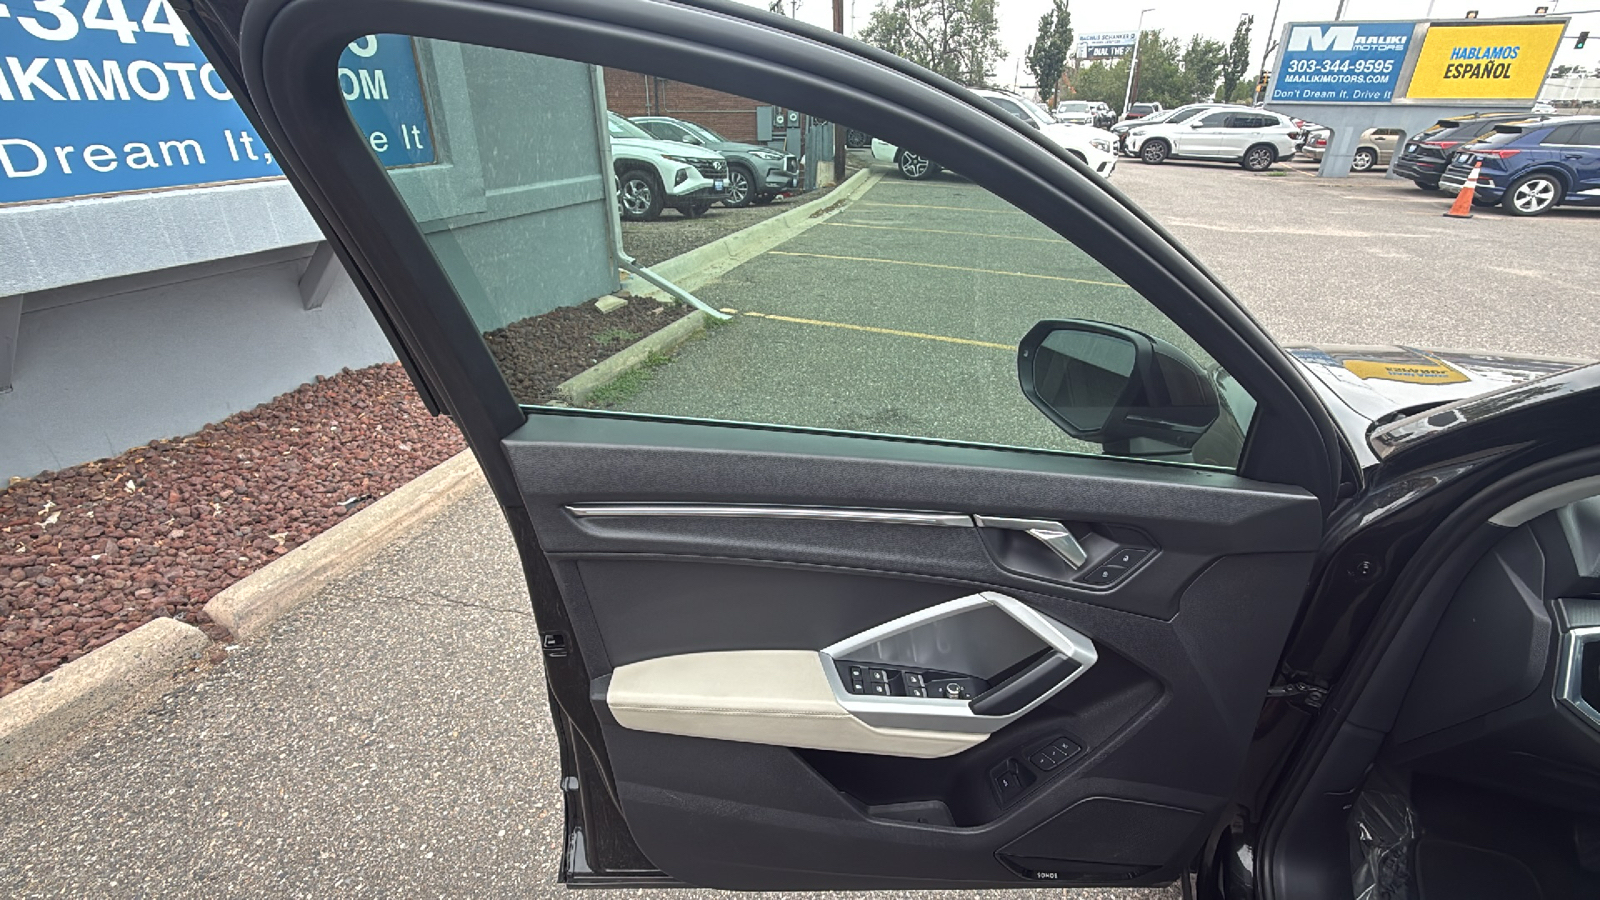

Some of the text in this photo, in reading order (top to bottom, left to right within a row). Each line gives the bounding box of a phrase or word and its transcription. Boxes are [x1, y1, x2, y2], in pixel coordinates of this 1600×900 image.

[1353, 44, 1404, 52] MOTORS
[1450, 46, 1520, 60] HABLAMOS
[1287, 59, 1395, 73] 303-344-9595
[1443, 60, 1512, 79] ESPAÑOL
[1284, 74, 1390, 84] MAALIKIMOTORS.COM
[1273, 89, 1300, 98] Don't
[1302, 89, 1336, 98] Dream
[1352, 89, 1381, 99] Drive
[1383, 90, 1392, 99] It
[0, 138, 206, 178] Dream
[401, 123, 424, 150] It
